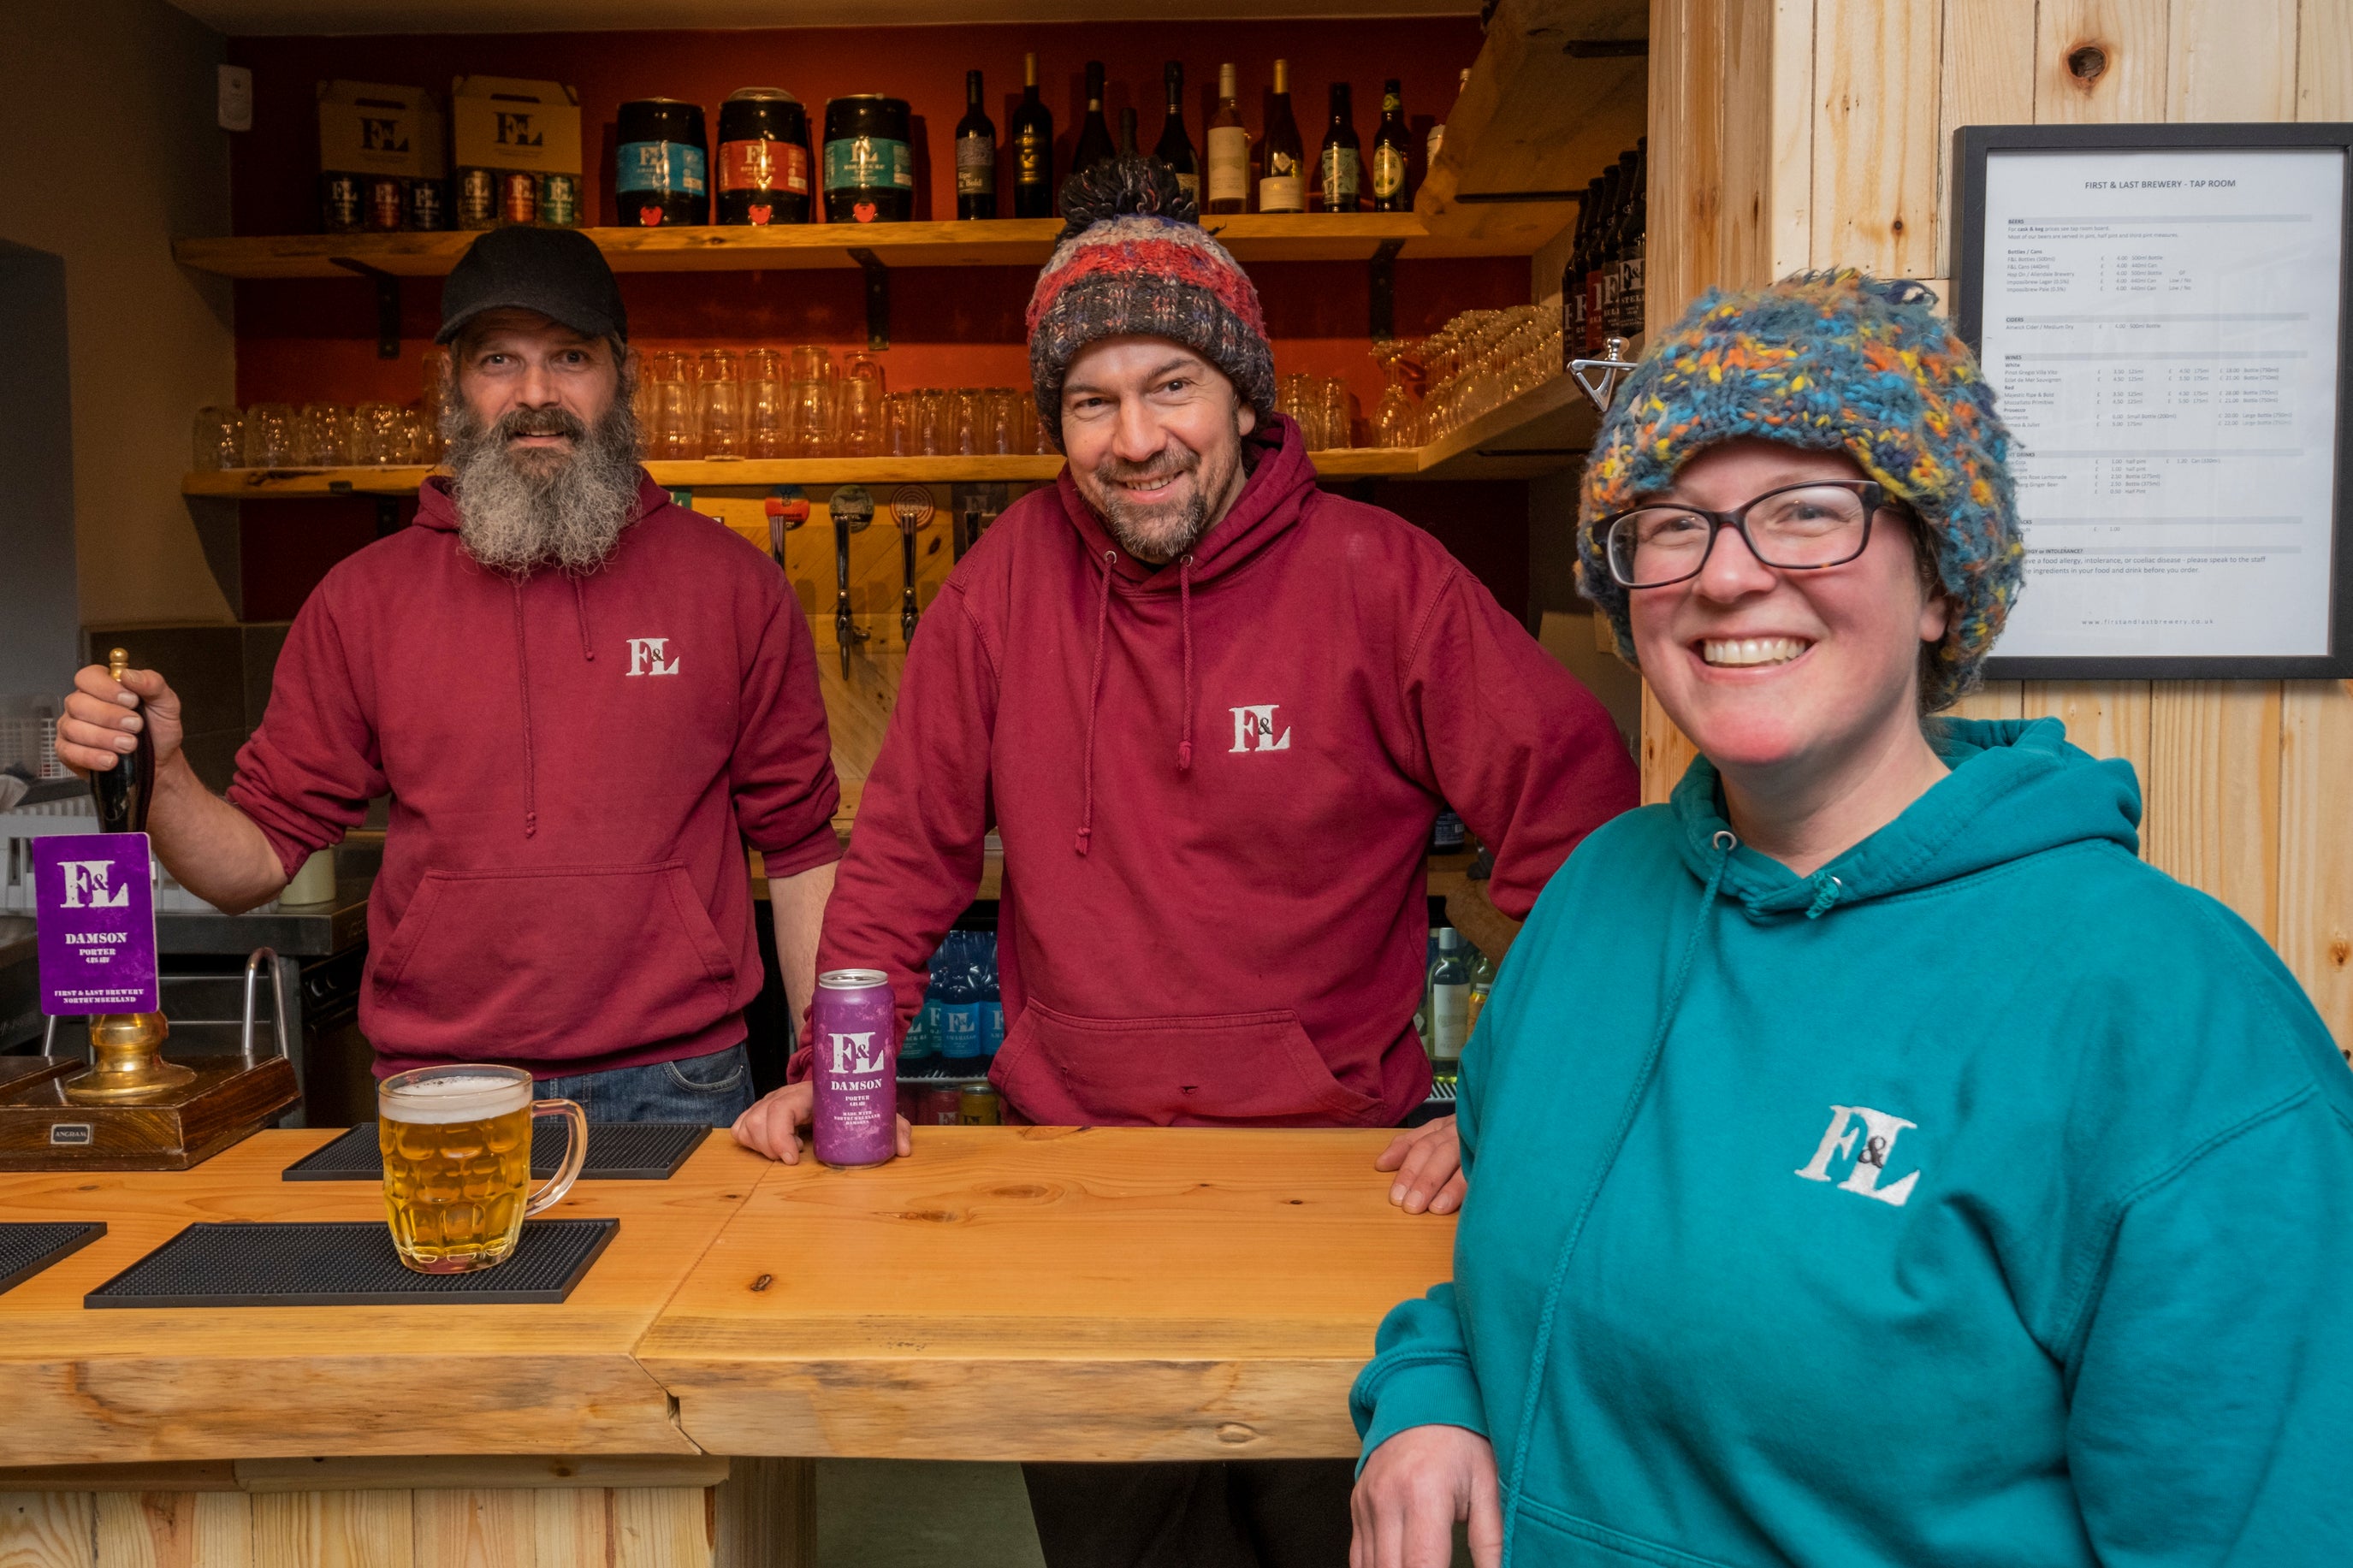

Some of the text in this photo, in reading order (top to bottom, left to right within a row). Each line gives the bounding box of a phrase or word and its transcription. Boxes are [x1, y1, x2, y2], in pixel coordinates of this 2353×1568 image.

[625, 637, 679, 676] F&L
[1228, 704, 1291, 753] F&L
[57, 860, 130, 908] F&L
[65, 932, 127, 944] DAMSON
[827, 1031, 885, 1074] F&L
[831, 1078, 882, 1091] DAMSON
[1794, 1105, 1921, 1207] F&L
